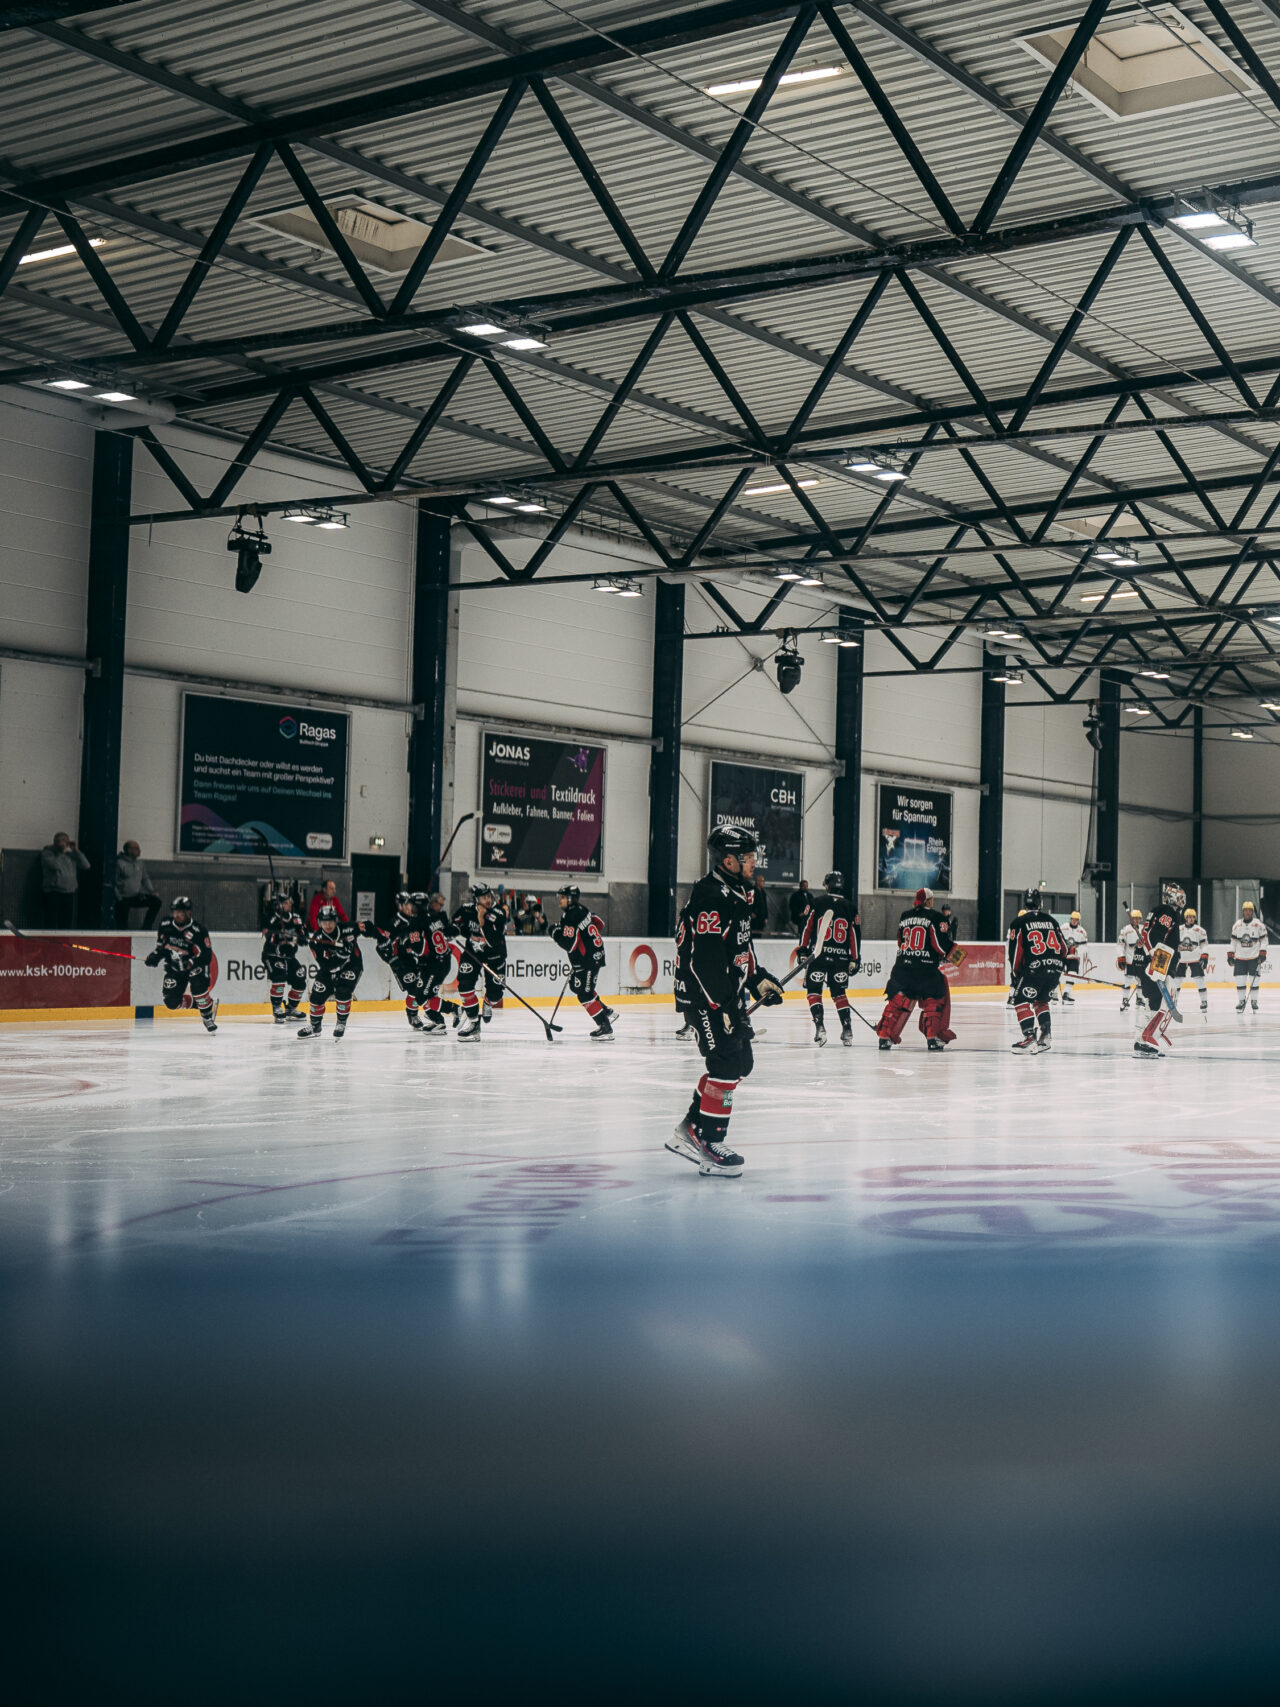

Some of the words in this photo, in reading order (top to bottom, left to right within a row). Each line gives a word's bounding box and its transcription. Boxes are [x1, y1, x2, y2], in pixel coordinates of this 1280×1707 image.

[300, 723, 336, 740] Ragas
[489, 740, 530, 760] JONAS
[194, 753, 204, 762] Du
[206, 754, 218, 763] bist
[219, 756, 258, 767] Dachdecker
[260, 760, 274, 769] oder
[275, 762, 290, 770] willst
[300, 764, 323, 773] werden
[208, 767, 230, 775] suchst
[243, 770, 260, 778] Team
[295, 774, 334, 785] Perspektive?
[194, 780, 212, 788] Dann
[213, 781, 235, 790] freuen
[489, 779, 526, 798] Stickerei
[530, 785, 547, 799] und
[551, 785, 596, 804] Textildruck
[194, 791, 212, 799] Team
[770, 789, 796, 805] CBH
[897, 795, 909, 806] Wir
[910, 799, 933, 811] sorgen
[493, 802, 523, 818] Aufkleber,
[526, 805, 550, 819] Fahnen,
[552, 807, 575, 821] Banner,
[577, 809, 594, 822] Folien
[892, 809, 902, 820] für
[904, 810, 937, 827] Spannung
[717, 814, 755, 828] DYNAMIK
[926, 844, 946, 855] Energie
[929, 837, 943, 846] Rhein
[697, 910, 721, 934] 62
[1026, 922, 1054, 931] LINDNER
[901, 926, 927, 951] 30
[1027, 930, 1061, 955] 34
[823, 947, 847, 955] TOYOTA
[0, 964, 106, 979] www.ksk-100pro.de
[506, 960, 570, 981] nEnergie
[701, 1014, 716, 1050] TOYOTA
